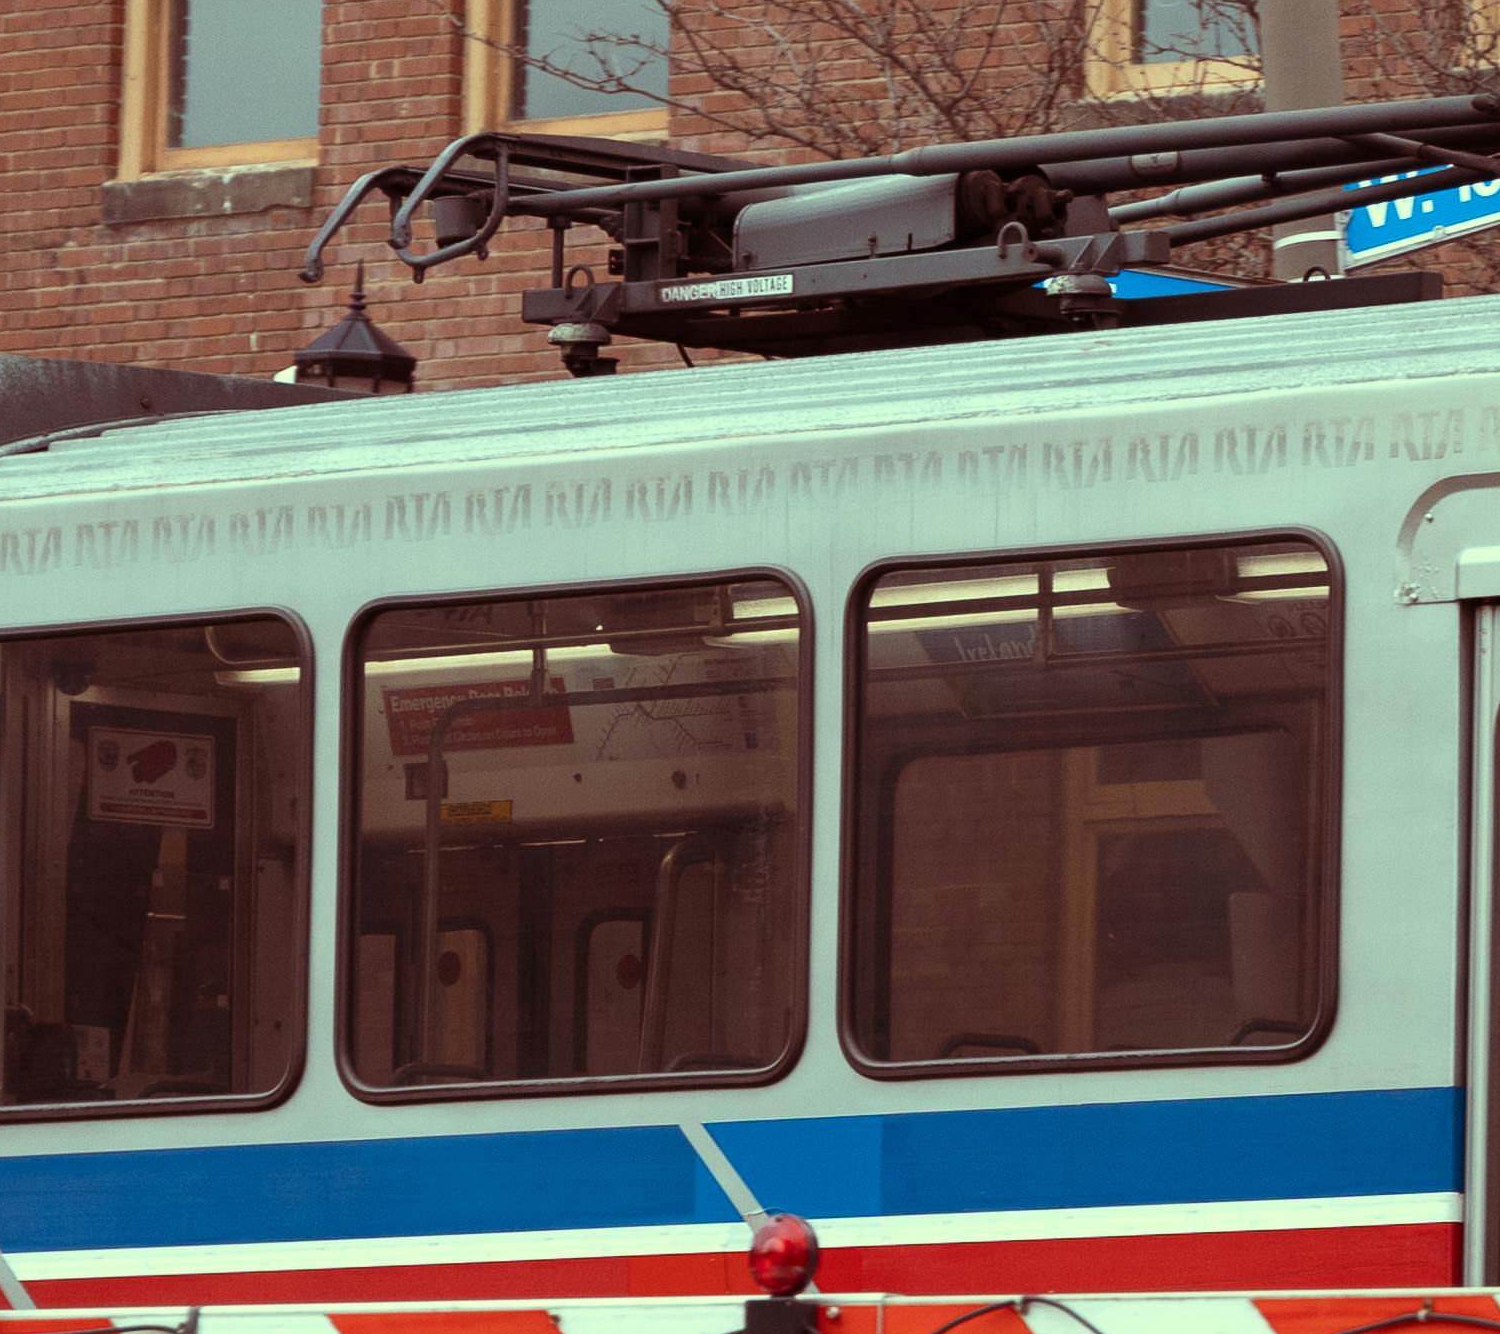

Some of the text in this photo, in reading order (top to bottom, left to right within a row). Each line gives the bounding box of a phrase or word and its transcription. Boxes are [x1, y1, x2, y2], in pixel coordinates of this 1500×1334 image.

[661, 276, 788, 302] DANGER HIGH VOLTAGE
[74, 519, 139, 568] RTA
[385, 491, 451, 541] RTA
[464, 484, 531, 535] RTA
[625, 474, 694, 523] RTA
[1126, 431, 1199, 483] RTA
[1214, 422, 1287, 475] RTA
[1388, 408, 1464, 461] RTA
